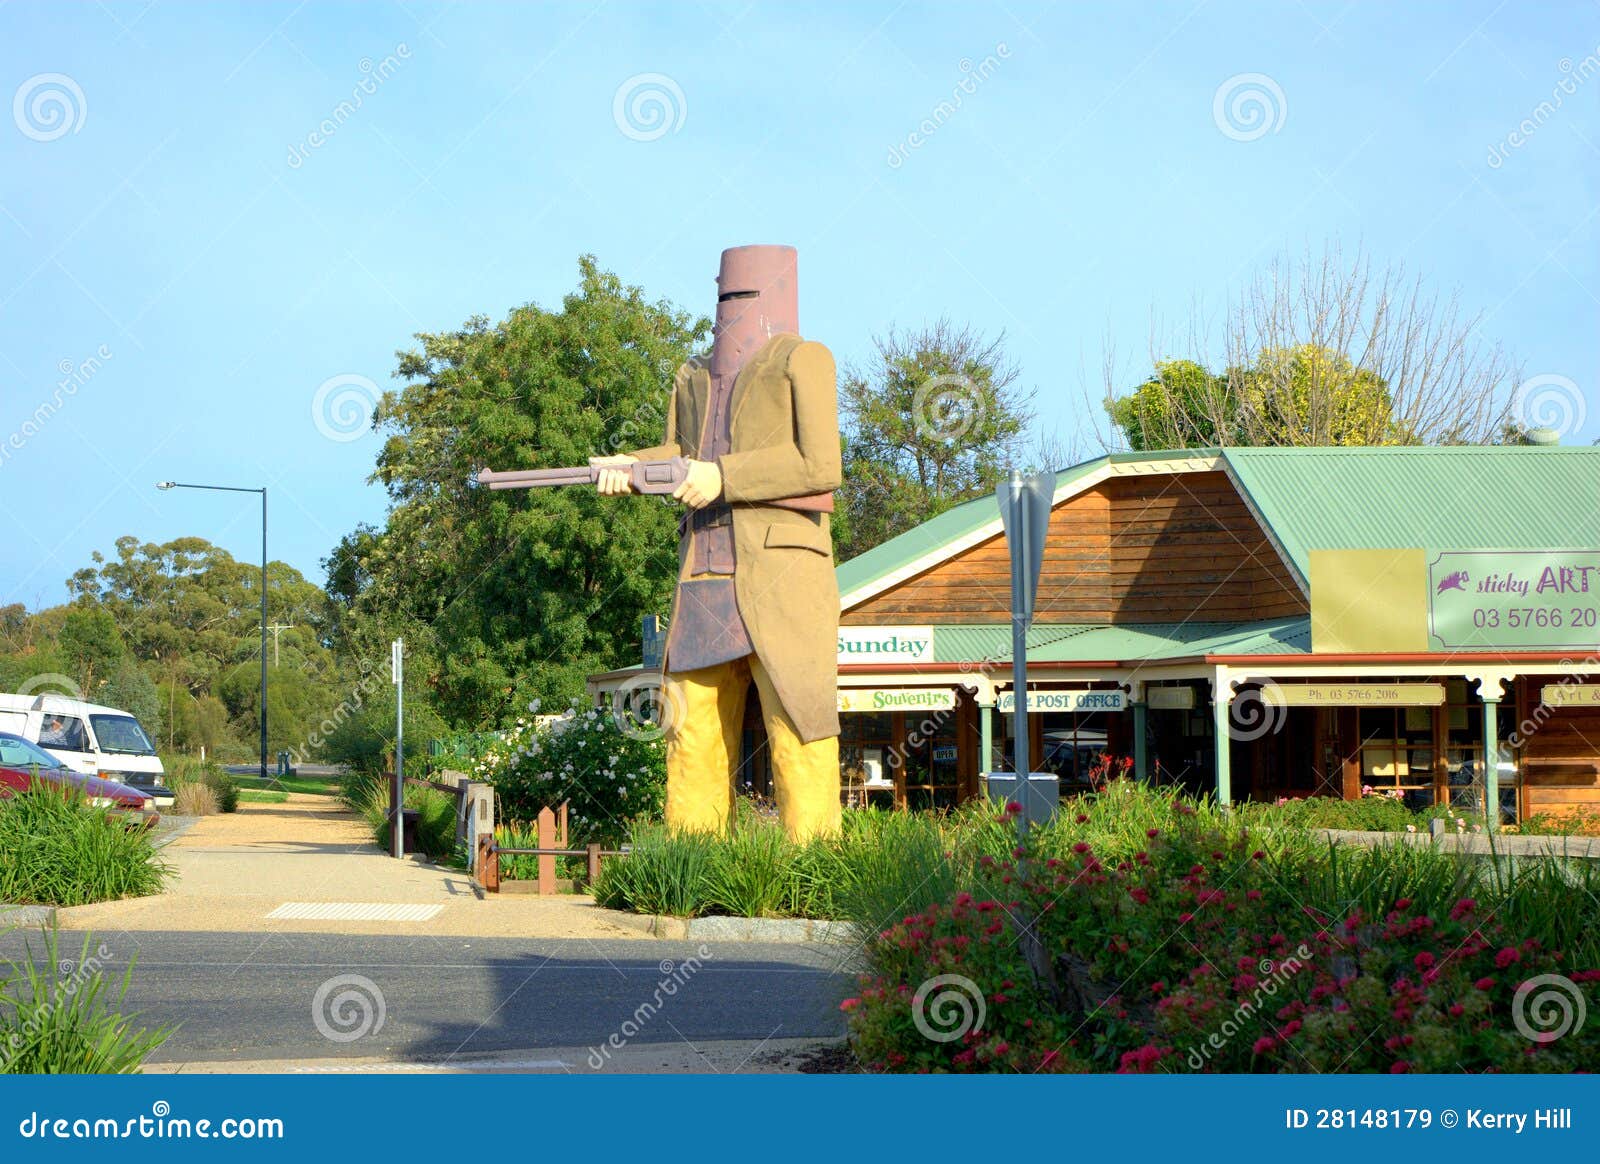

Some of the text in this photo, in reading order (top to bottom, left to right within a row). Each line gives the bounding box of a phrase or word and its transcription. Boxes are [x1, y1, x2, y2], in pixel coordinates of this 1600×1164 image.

[1476, 565, 1600, 596] sticky ART
[1473, 608, 1600, 628] 03 5766 20
[873, 691, 950, 709] Souvenirs
[1036, 695, 1070, 707] POST
[1077, 694, 1121, 707] OFFICE
[1330, 690, 1342, 699] 03
[1376, 689, 1398, 699] 2016
